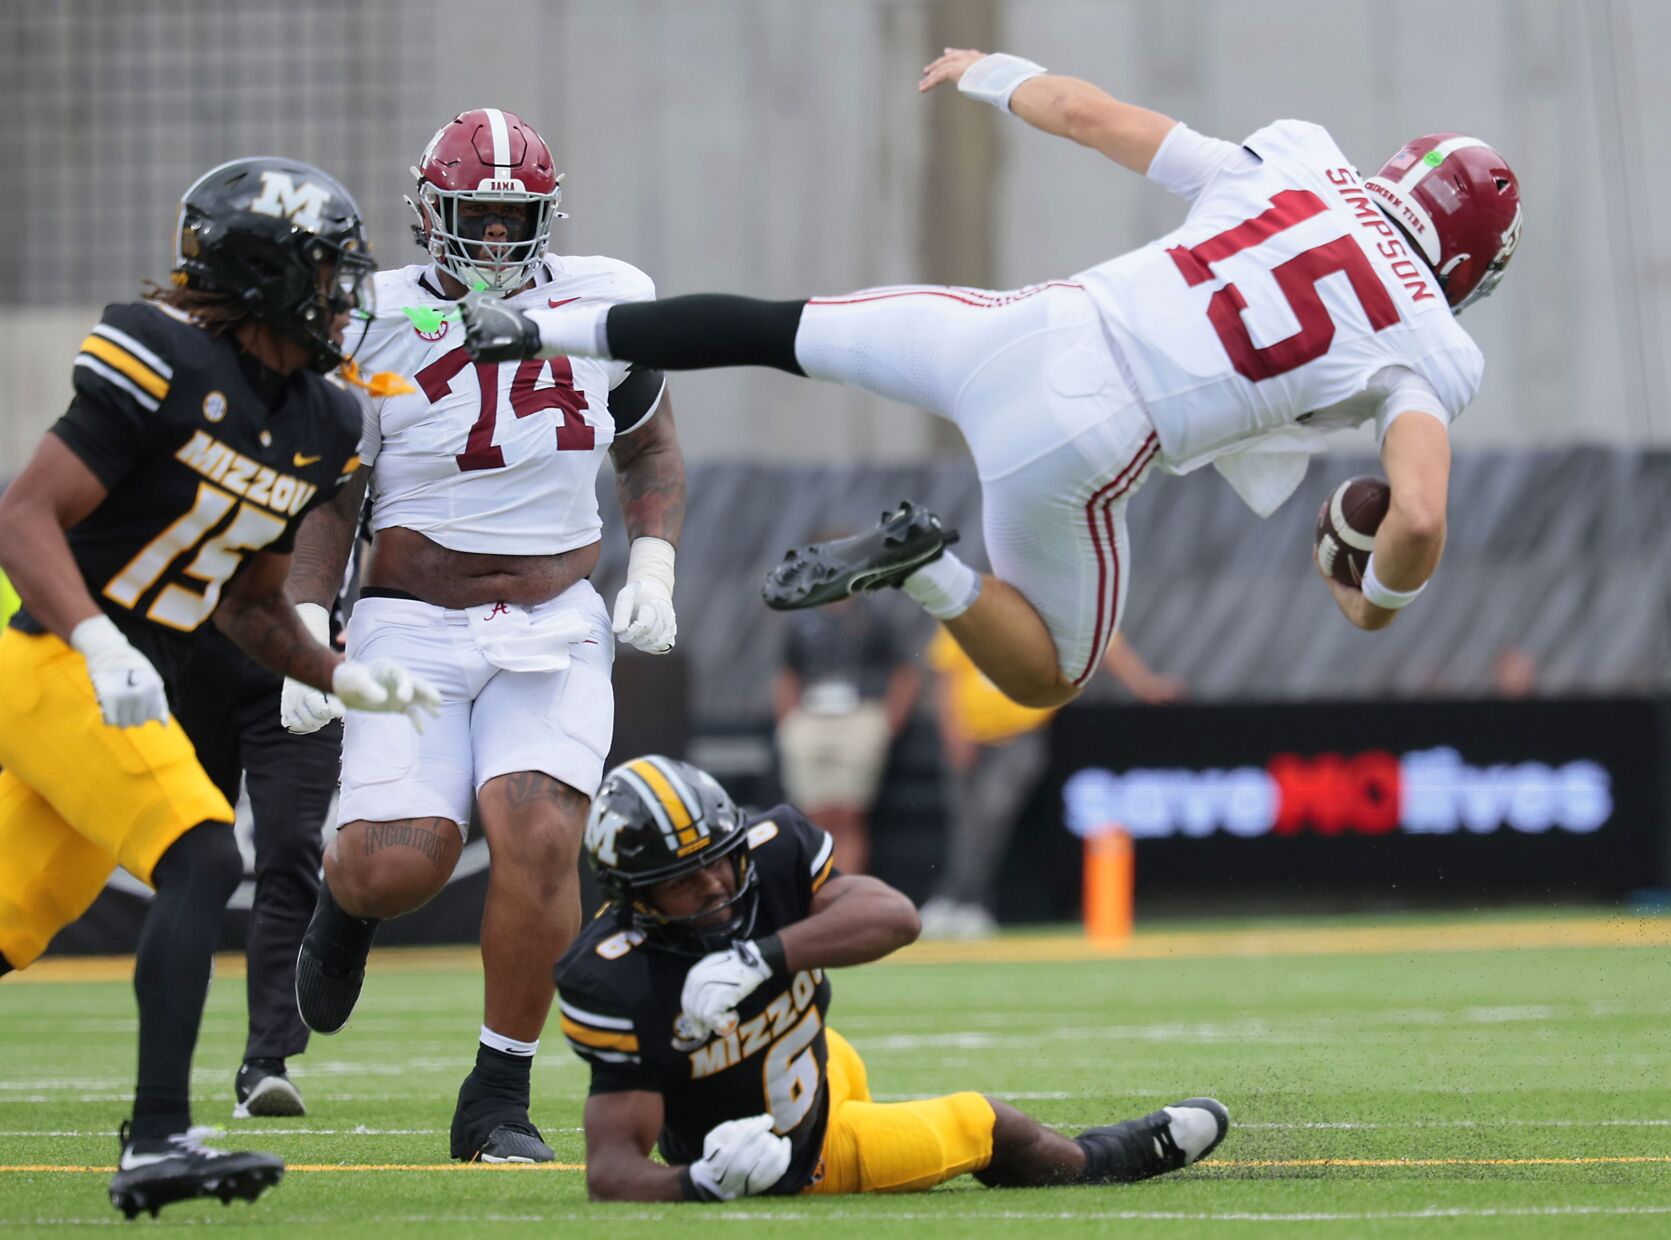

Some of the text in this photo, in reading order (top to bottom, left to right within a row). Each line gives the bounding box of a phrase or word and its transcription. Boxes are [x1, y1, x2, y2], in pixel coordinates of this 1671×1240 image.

[252, 170, 331, 234] M
[491, 181, 515, 191] BAMA
[1326, 166, 1437, 304] SIMPSON
[1164, 189, 1401, 383] 15
[414, 344, 595, 471] 74
[175, 430, 317, 518] MIZZOU
[102, 480, 287, 632] 15
[483, 600, 511, 621] A
[584, 799, 629, 867] M
[762, 1002, 822, 1136] 6
